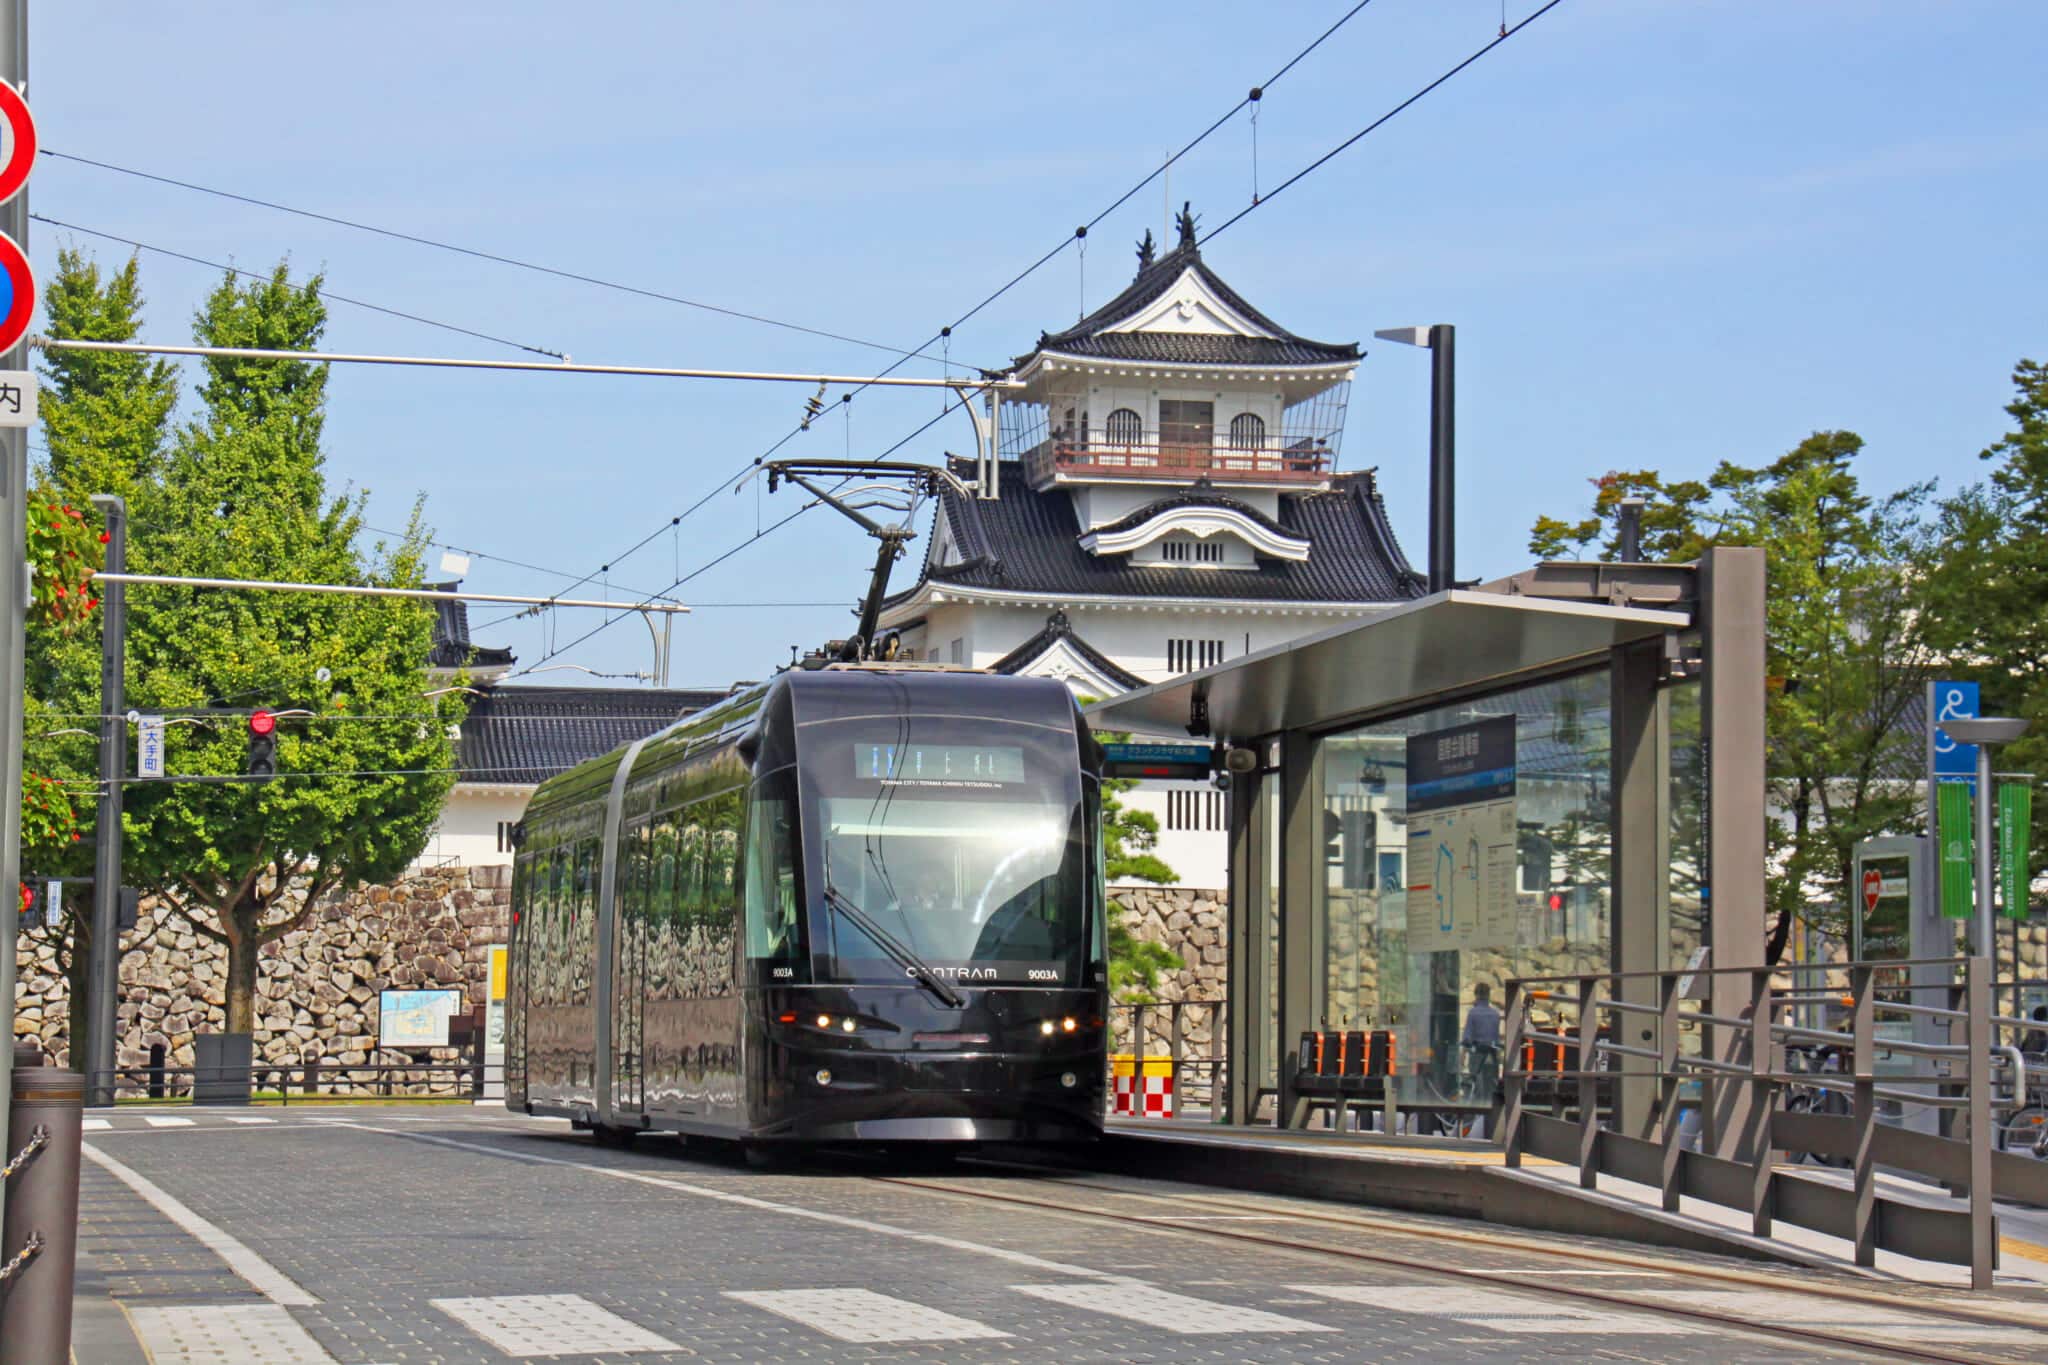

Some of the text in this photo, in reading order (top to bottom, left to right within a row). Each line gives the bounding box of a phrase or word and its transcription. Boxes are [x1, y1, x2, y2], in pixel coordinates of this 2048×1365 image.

[0, 382, 21, 413] 内
[144, 730, 158, 771] 大手町
[773, 967, 793, 978] 9003A
[1028, 969, 1058, 980] 9003A
